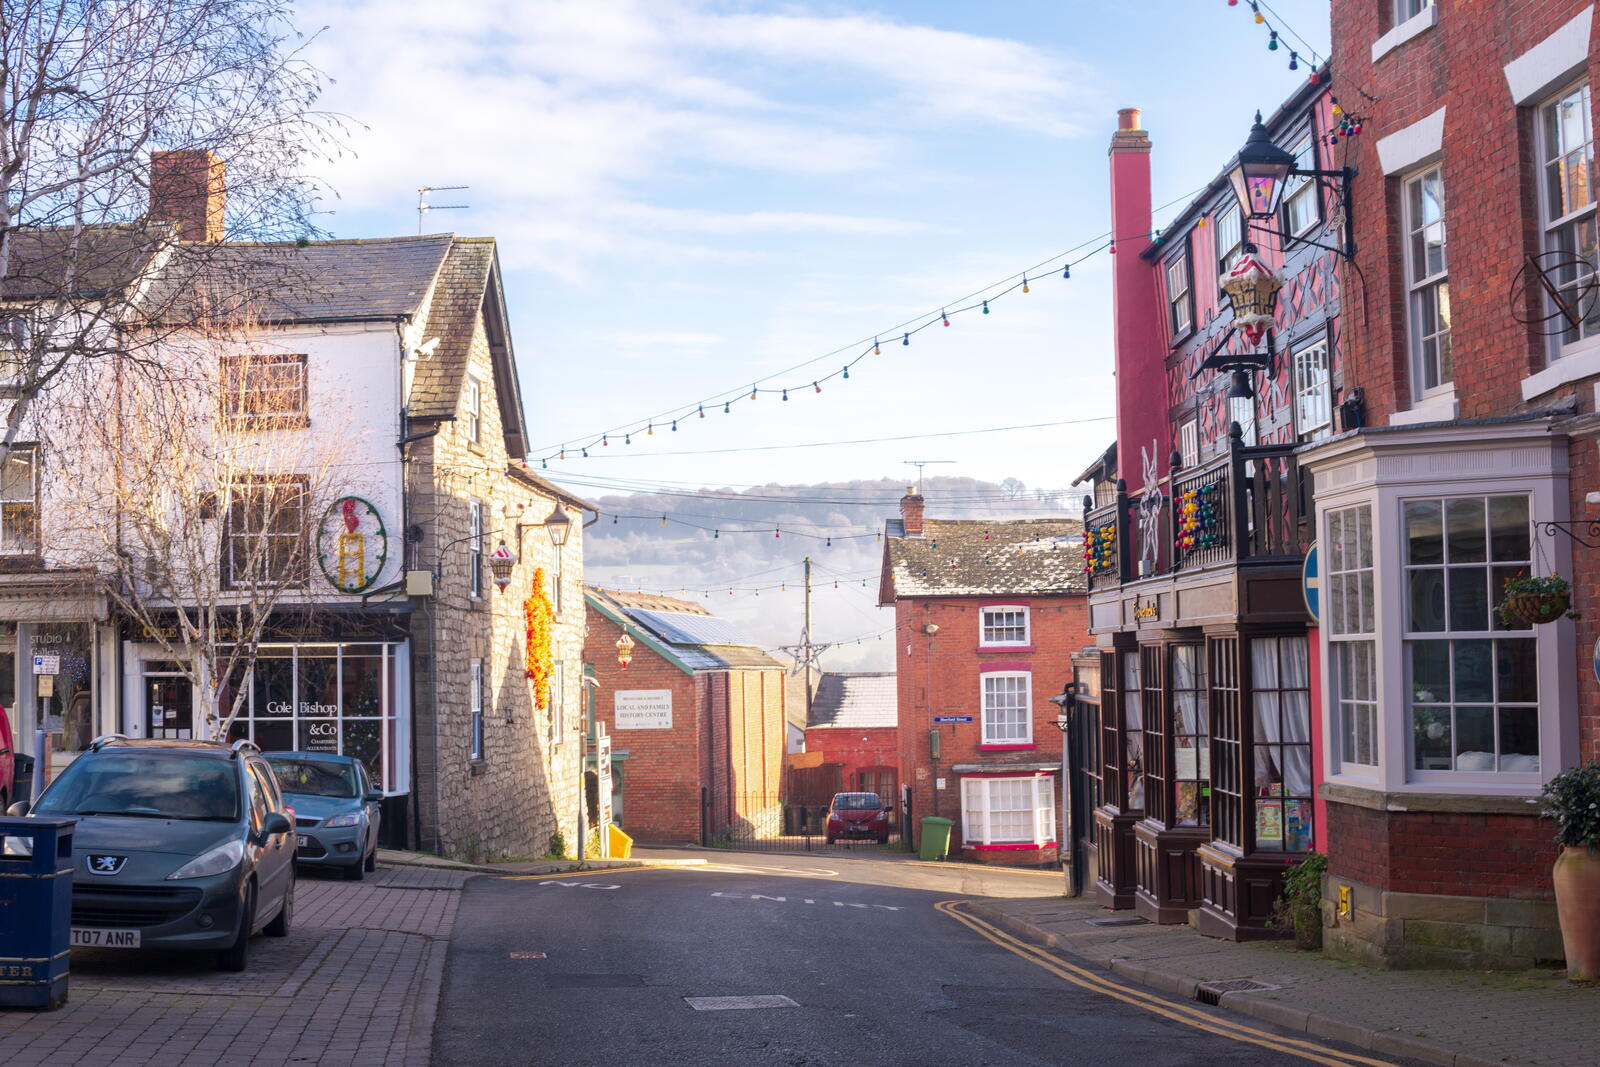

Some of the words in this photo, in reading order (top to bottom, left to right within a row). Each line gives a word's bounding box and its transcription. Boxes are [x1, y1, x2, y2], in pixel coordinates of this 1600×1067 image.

[30, 635, 62, 644] STUDIO
[266, 701, 292, 714] Cole
[299, 701, 338, 717] Bishop
[309, 723, 337, 735] &Co
[538, 880, 622, 890] NO
[105, 931, 134, 945] ANR
